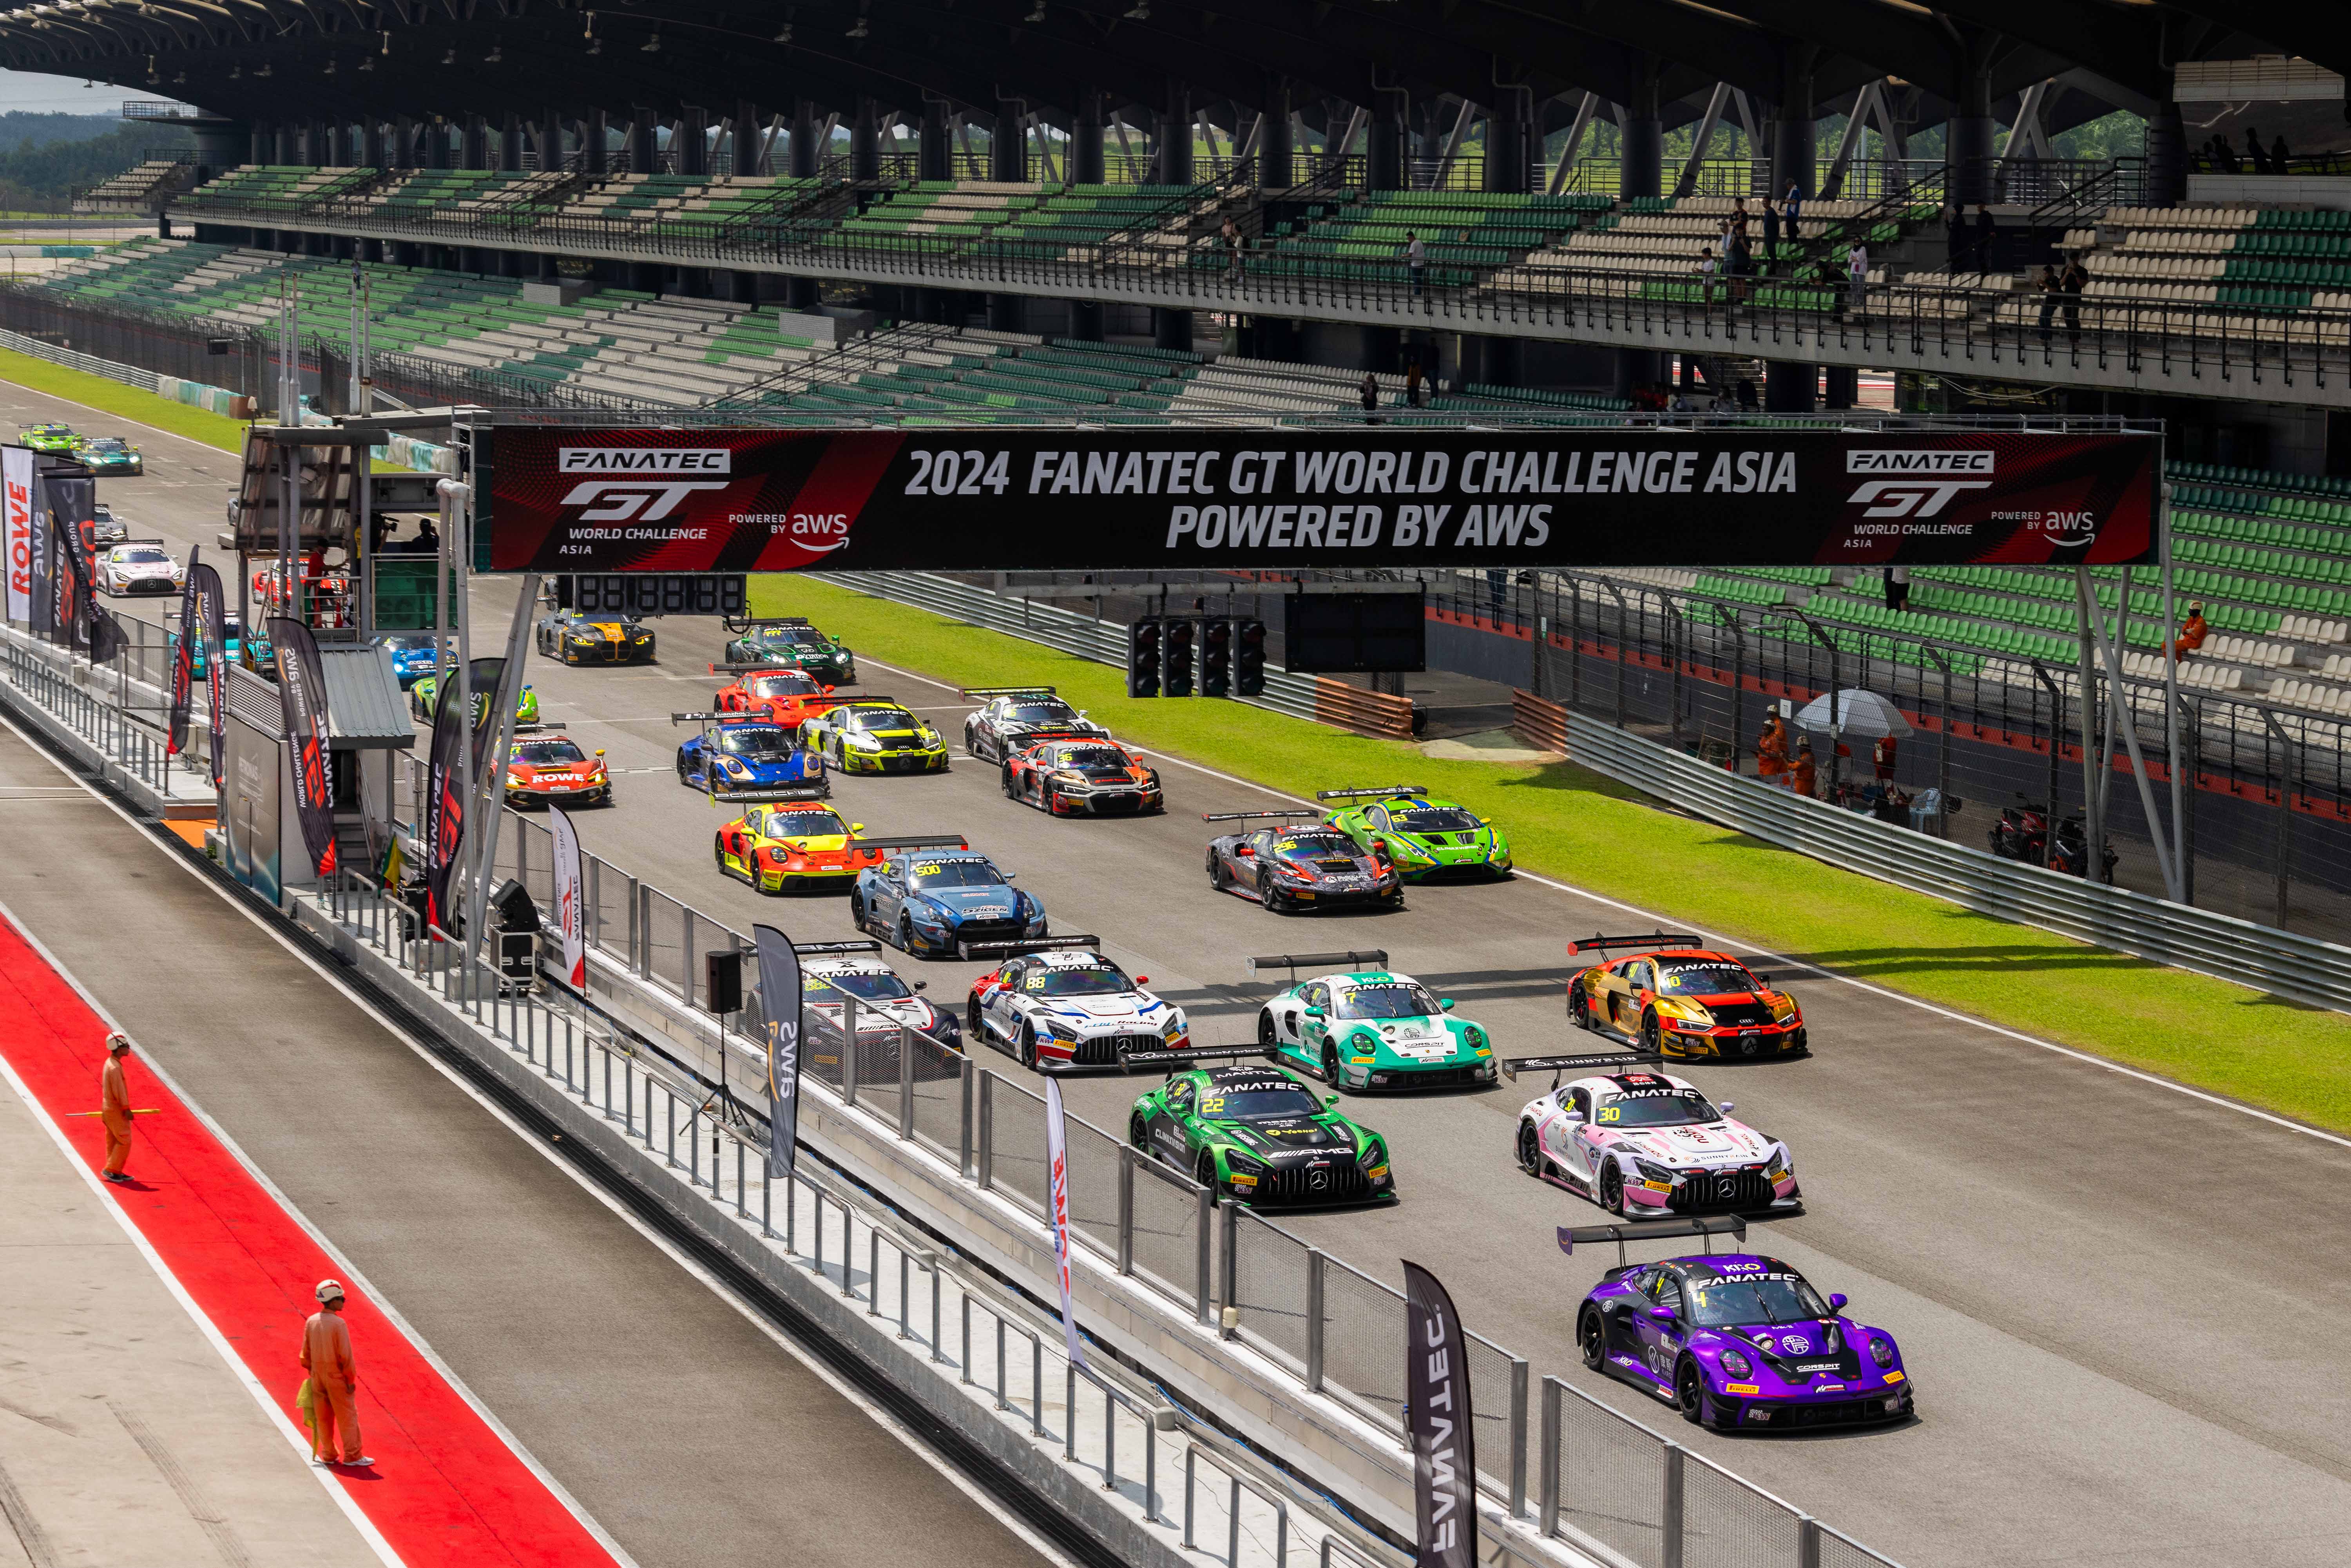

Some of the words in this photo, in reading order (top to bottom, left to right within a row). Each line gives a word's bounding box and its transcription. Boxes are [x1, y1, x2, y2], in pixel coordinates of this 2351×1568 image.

[565, 452, 724, 469] FANATEC
[1852, 454, 1991, 469] FANATEC
[904, 450, 1010, 496] 2024
[1029, 451, 1217, 494] FANATEC
[1229, 451, 1286, 494] GT
[1295, 451, 1448, 494] WORLD
[1460, 451, 1696, 494] CHALLENGE
[1702, 451, 1796, 494] ASIA
[560, 481, 730, 521] GT
[1846, 481, 1993, 517] GT
[729, 514, 786, 523] POWERED
[1991, 512, 2041, 520] POWERED
[2046, 512, 2094, 531] aws
[771, 525, 786, 534] BY
[792, 514, 848, 534] aws
[1166, 505, 1377, 548] POWERED
[1392, 504, 1451, 547] BY
[1453, 504, 1552, 547] AWS
[2027, 521, 2040, 530] BY
[570, 528, 621, 539] WORLD
[625, 528, 708, 540] CHALLENGE
[1855, 525, 1899, 535] WORLD
[1902, 525, 1972, 534] CHALLENGE
[9, 482, 31, 595] ROWE
[1844, 539, 1872, 548] ASIA
[560, 545, 592, 554] ASIA
[1058, 753, 1072, 763] 36
[531, 773, 585, 784] ROWE
[715, 789, 816, 798] PORSCHE
[429, 763, 443, 869] FANATEC
[1282, 833, 1344, 842] FANATEC
[1273, 841, 1297, 853] 296
[916, 858, 984, 867] FANATEC
[915, 865, 941, 877] 500
[1036, 964, 1110, 976] FANATEC
[1663, 964, 1741, 975] FANATEC
[1025, 976, 1046, 990] 88
[1342, 983, 1416, 994] FANATEC
[1054, 1040, 1076, 1048] PIRELLI
[1554, 1056, 1637, 1065] SUNNYRAIN
[1505, 1063, 1513, 1072] aws
[1208, 1082, 1299, 1097] FANATEC
[1605, 1090, 1695, 1104] FANATEC
[1202, 1098, 1224, 1113] 22
[1598, 1107, 1619, 1122] 30
[1647, 1182, 1670, 1192] PIRELLI
[1697, 1273, 1798, 1289] FANATEC
[1796, 1363, 1840, 1372] CONSPIT
[1729, 1384, 1758, 1393] PIRELLI
